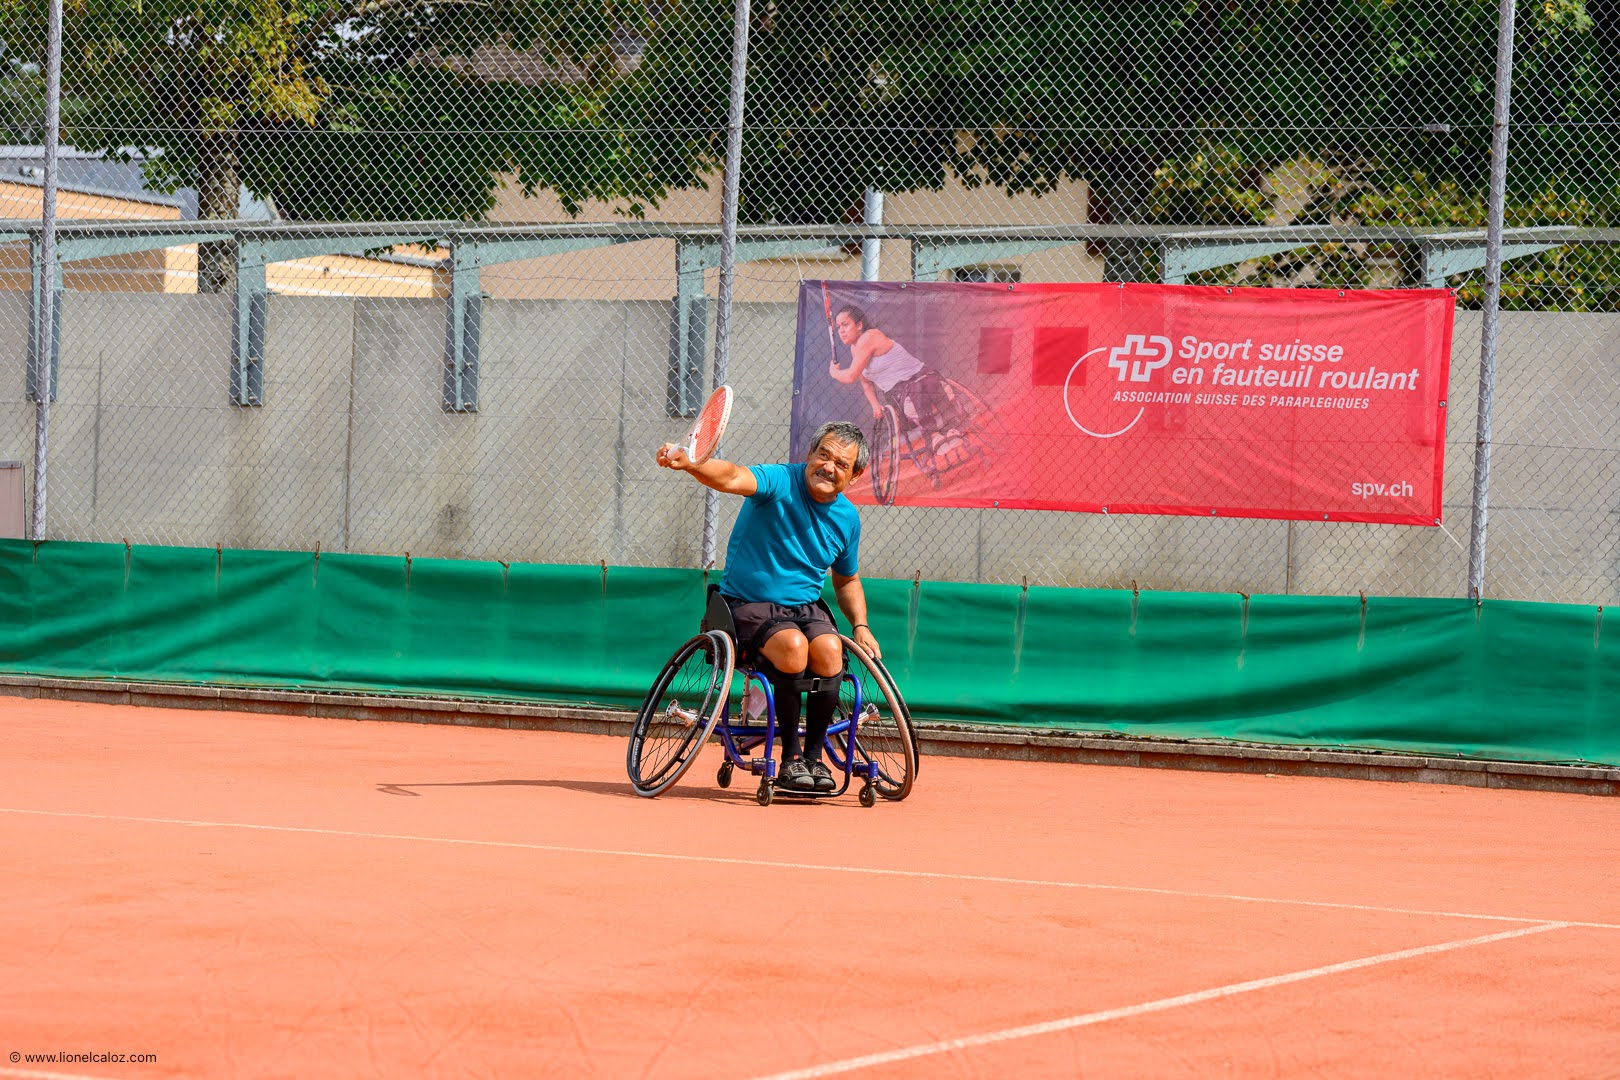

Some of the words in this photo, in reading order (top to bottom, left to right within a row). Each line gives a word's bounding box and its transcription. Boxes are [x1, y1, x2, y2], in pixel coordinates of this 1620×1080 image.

[1178, 336, 1251, 363] Sport
[1259, 339, 1343, 363] suisse
[1172, 366, 1204, 385] en
[1212, 364, 1312, 389] fauteuil
[1319, 368, 1419, 391] roulant
[1113, 390, 1191, 404] ASSOCIATION
[1195, 393, 1238, 406] SUISSE
[1242, 395, 1266, 407] DES
[1270, 396, 1370, 410] PARAPLEGIQUES
[1351, 480, 1414, 500] spv.ch
